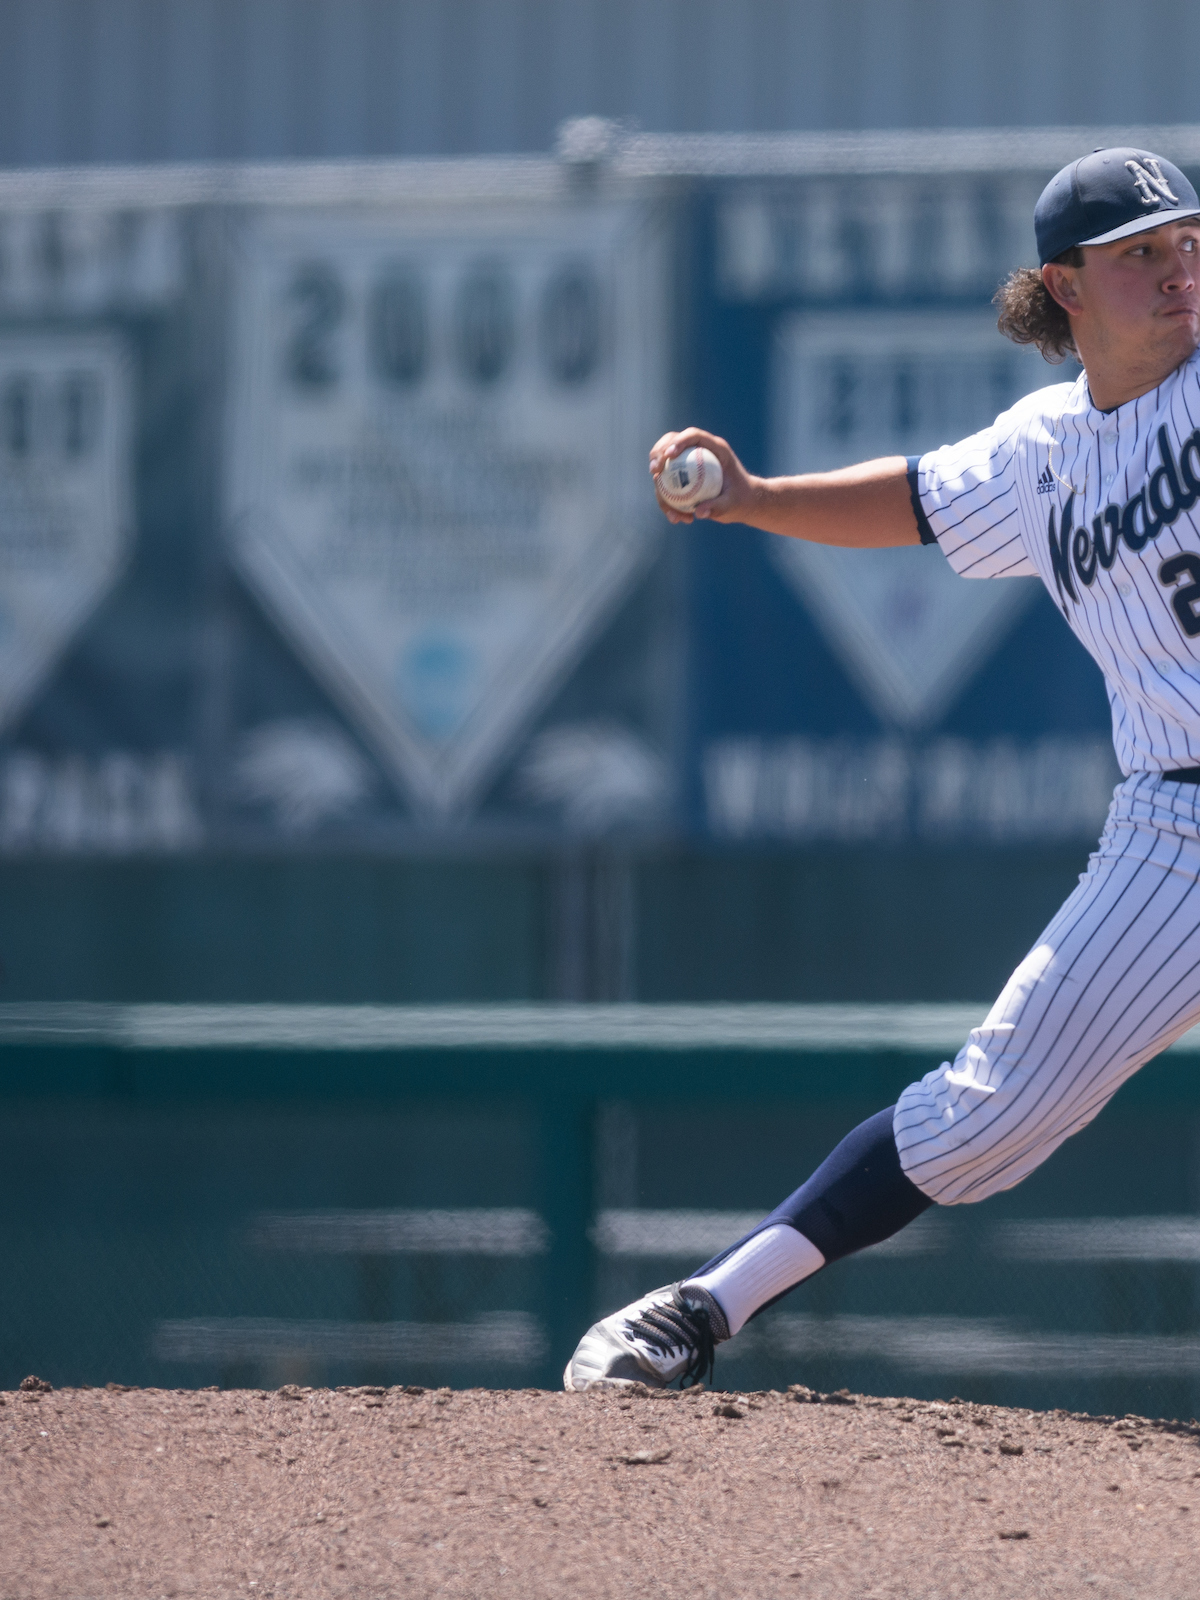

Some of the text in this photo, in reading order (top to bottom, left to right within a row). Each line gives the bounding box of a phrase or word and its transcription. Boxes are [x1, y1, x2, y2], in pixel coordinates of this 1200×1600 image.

[1124, 158, 1178, 206] N
[289, 252, 608, 392] 2000
[1036, 483, 1056, 495] adidas
